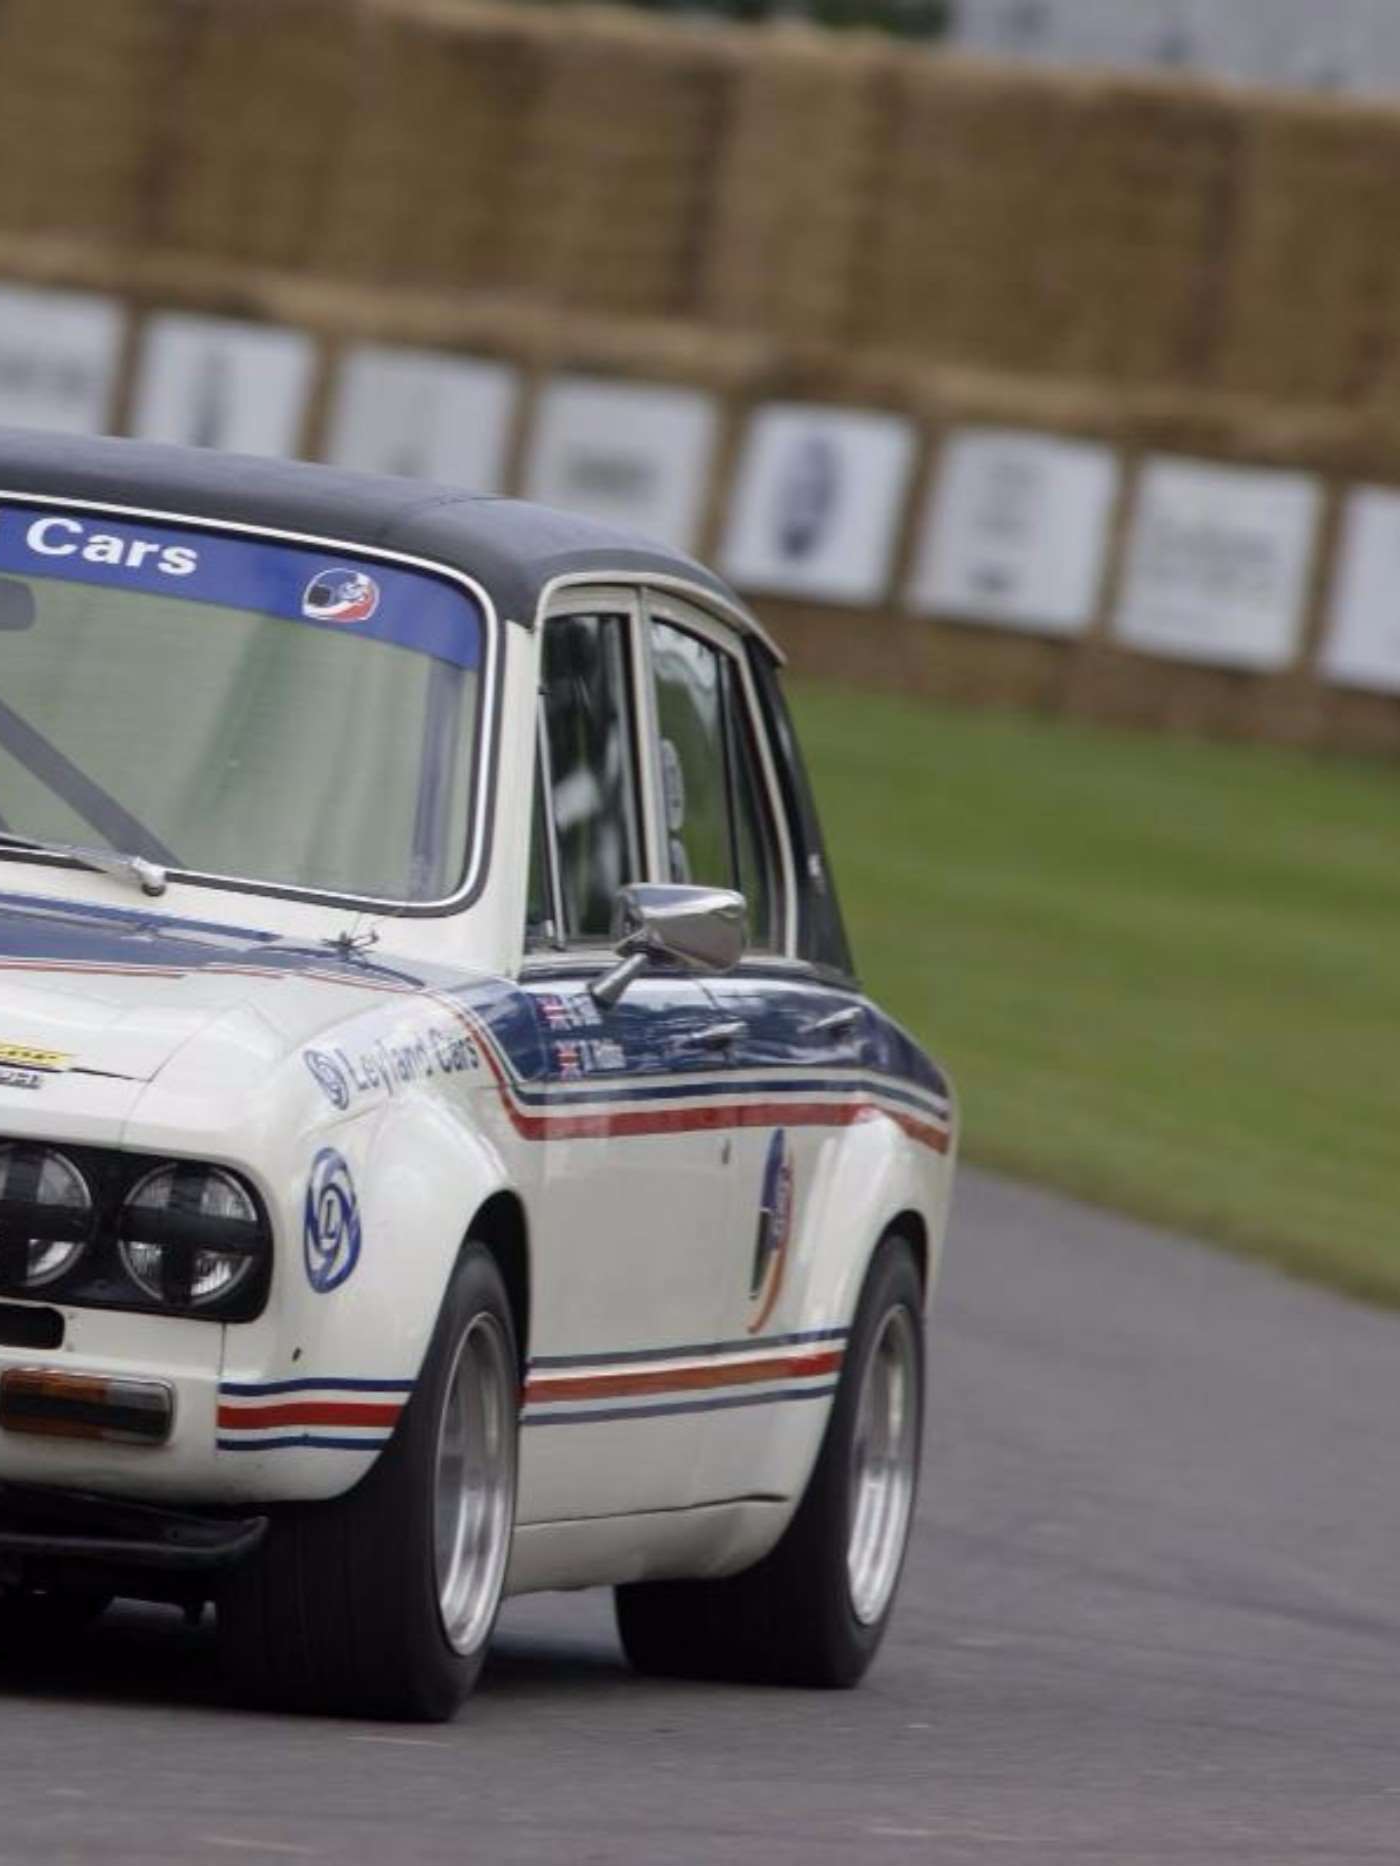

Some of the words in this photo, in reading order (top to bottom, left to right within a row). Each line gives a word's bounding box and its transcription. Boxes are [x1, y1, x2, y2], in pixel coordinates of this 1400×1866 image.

[25, 516, 199, 576] Cars
[334, 1036, 434, 1097] Leyland
[429, 1028, 480, 1074] Cars
